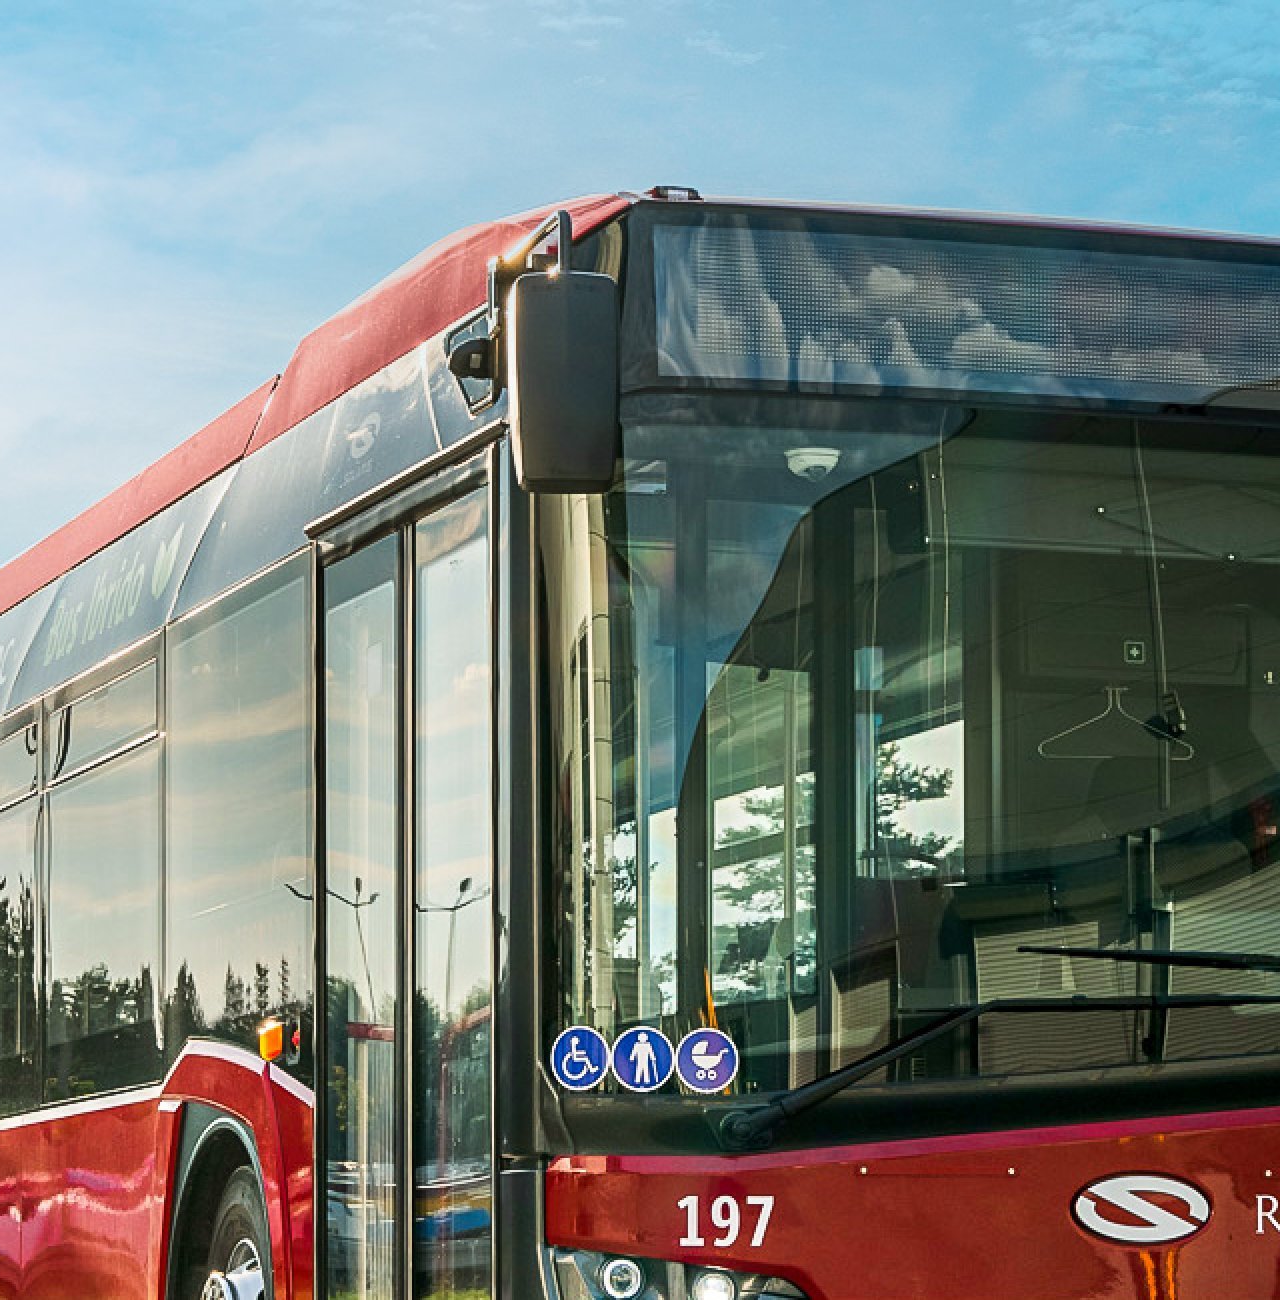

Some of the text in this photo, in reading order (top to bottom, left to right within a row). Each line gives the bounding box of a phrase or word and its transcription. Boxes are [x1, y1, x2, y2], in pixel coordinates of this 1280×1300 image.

[43, 551, 145, 667] Bus Ibrido
[677, 1194, 775, 1247] 197
